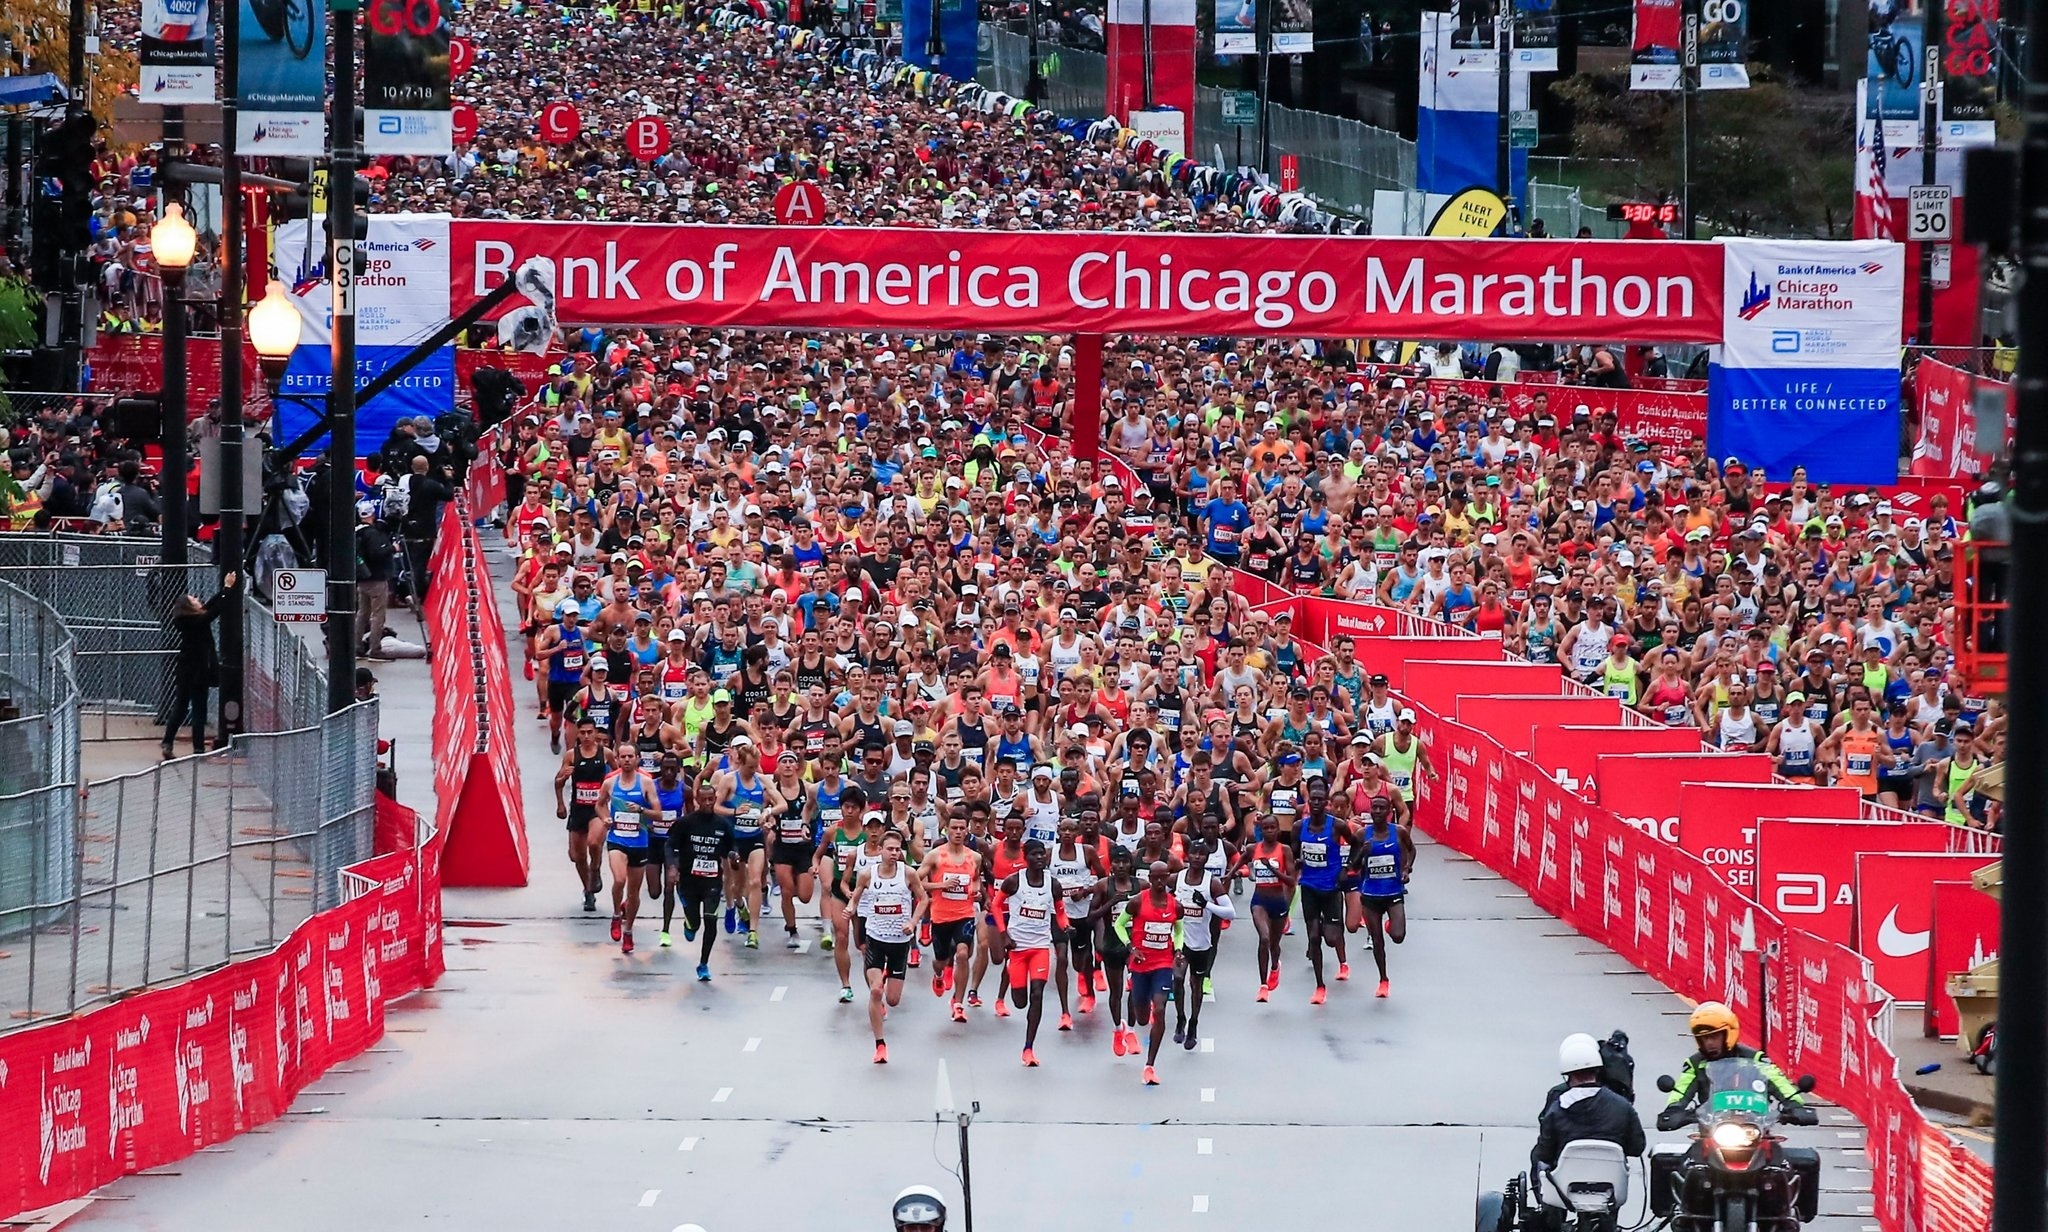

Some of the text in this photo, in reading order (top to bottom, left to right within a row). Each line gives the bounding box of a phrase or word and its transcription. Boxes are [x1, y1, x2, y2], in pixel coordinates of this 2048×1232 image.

[370, 0, 440, 36] GO
[1703, 0, 1741, 23] GO
[1946, 22, 1990, 49] CA
[150, 50, 207, 59] #ChicagoMarathon
[1945, 48, 1991, 76] GO
[248, 94, 315, 103] #ChicagoMarathon
[550, 106, 568, 132] C
[638, 122, 659, 148] B
[1140, 128, 1180, 138] aggreko
[1912, 190, 1948, 199] SPEED
[785, 186, 813, 218] A
[1462, 201, 1492, 216] ALERT
[1916, 201, 1944, 210] LIMIT
[1459, 213, 1489, 228] LEVEL
[1914, 213, 1946, 233] 30
[368, 242, 409, 252] America
[1778, 264, 1856, 277] Bank of America
[356, 274, 406, 286] rathon
[474, 240, 1693, 328] Bnk of America Chicago Marathon
[1777, 279, 1838, 298] Chicago
[1777, 296, 1853, 312] Marathon
[286, 375, 441, 388] BETTE COECTED
[1786, 382, 1832, 394] LIFE /
[1637, 404, 1661, 416] Bank
[1661, 405, 1671, 417] of
[1732, 398, 1887, 411] BETTER CONNECTED
[1636, 421, 1692, 443] Chicago
[1791, 752, 1803, 760] 514
[1036, 832, 1049, 840] 479
[1741, 828, 1756, 844] T
[1303, 853, 1319, 861] PACE
[1703, 848, 1754, 865] CONS
[1057, 868, 1078, 876] ARMY
[1725, 1095, 1754, 1106] TV 1
